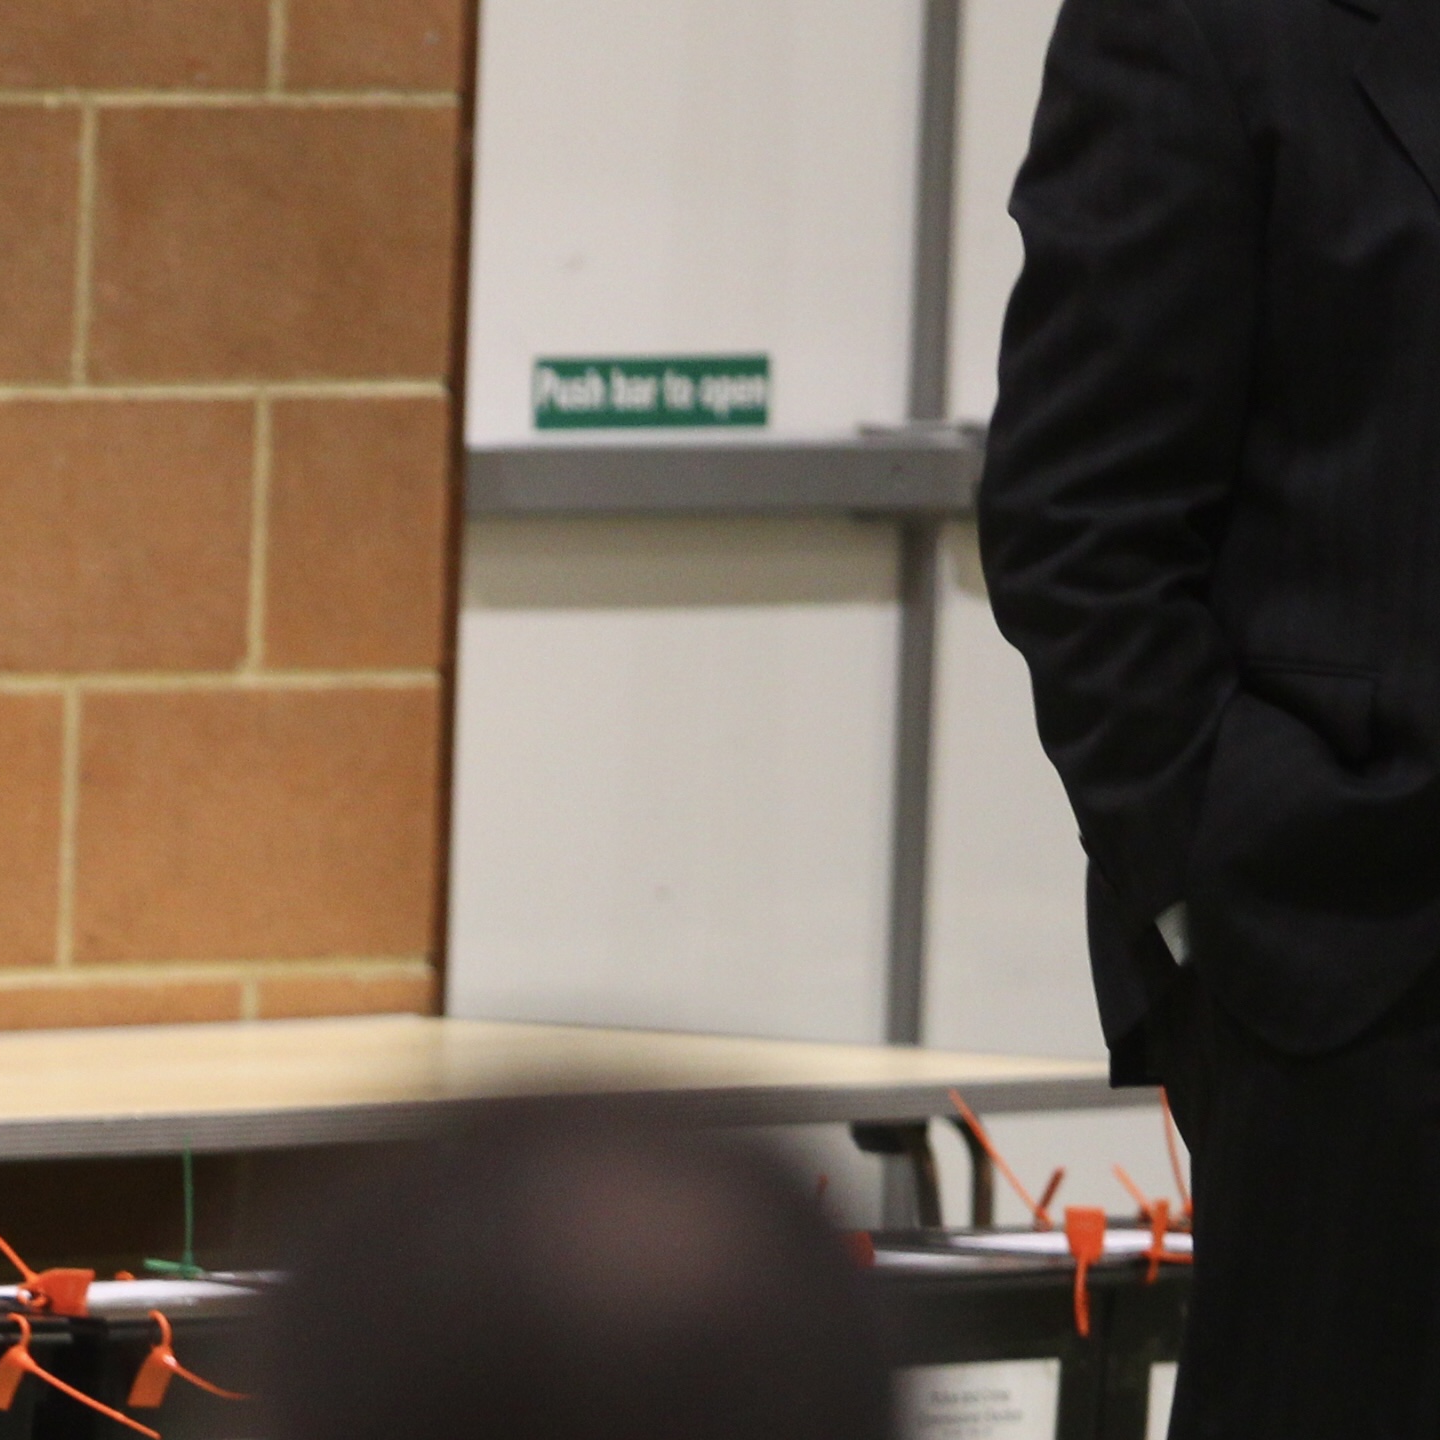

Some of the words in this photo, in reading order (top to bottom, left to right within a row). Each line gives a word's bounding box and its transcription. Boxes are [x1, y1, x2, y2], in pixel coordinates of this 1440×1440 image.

[536, 366, 605, 411] Push
[610, 366, 657, 410] bar
[663, 366, 693, 410] to
[700, 374, 766, 421] open
